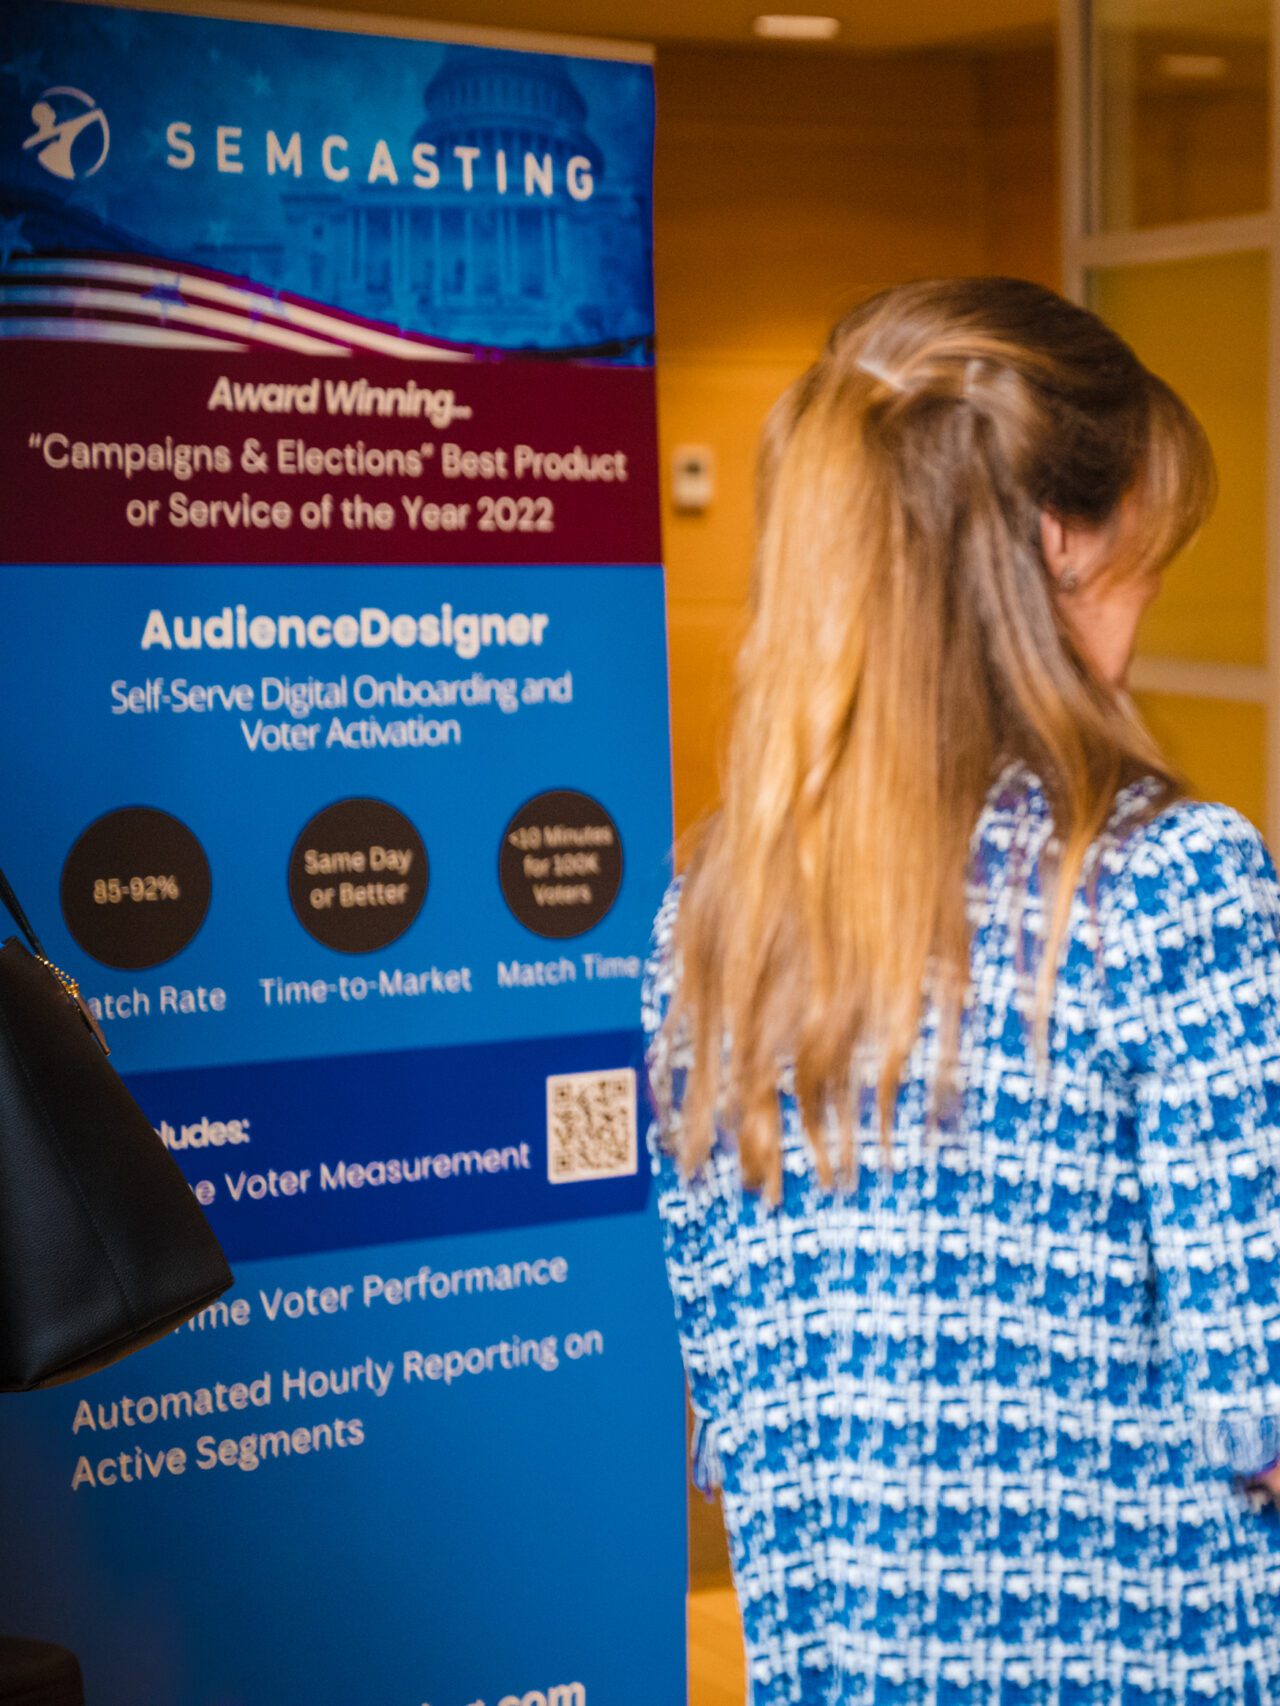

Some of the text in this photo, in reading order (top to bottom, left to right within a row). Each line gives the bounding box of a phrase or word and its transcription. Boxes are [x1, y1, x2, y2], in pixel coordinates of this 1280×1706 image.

[166, 121, 594, 202] SEMCASTING
[207, 376, 320, 414] Award
[240, 437, 269, 474] &
[441, 442, 508, 479] Best
[513, 444, 628, 481] Product
[126, 491, 554, 532] or Service of the Year 2022
[140, 603, 549, 659] AudienceDesigner
[111, 671, 573, 718] Self-Serve Digital Onboarding and
[240, 714, 462, 752] Voter Activation
[304, 845, 413, 875] Same Day
[93, 874, 180, 905] 85-92%
[309, 882, 408, 910] or Better
[260, 966, 472, 1006] Time-to-Market
[497, 953, 640, 988] Match Time
[88, 985, 227, 1021] atch Rate
[153, 1116, 250, 1151] ludes:
[224, 1169, 311, 1201] Voter
[319, 1142, 530, 1191] Measurement
[259, 1284, 354, 1321] Voter
[363, 1256, 569, 1308] Performance
[72, 1329, 604, 1435] Automated Hourly Reporting on
[72, 1418, 365, 1491] Active Segments
